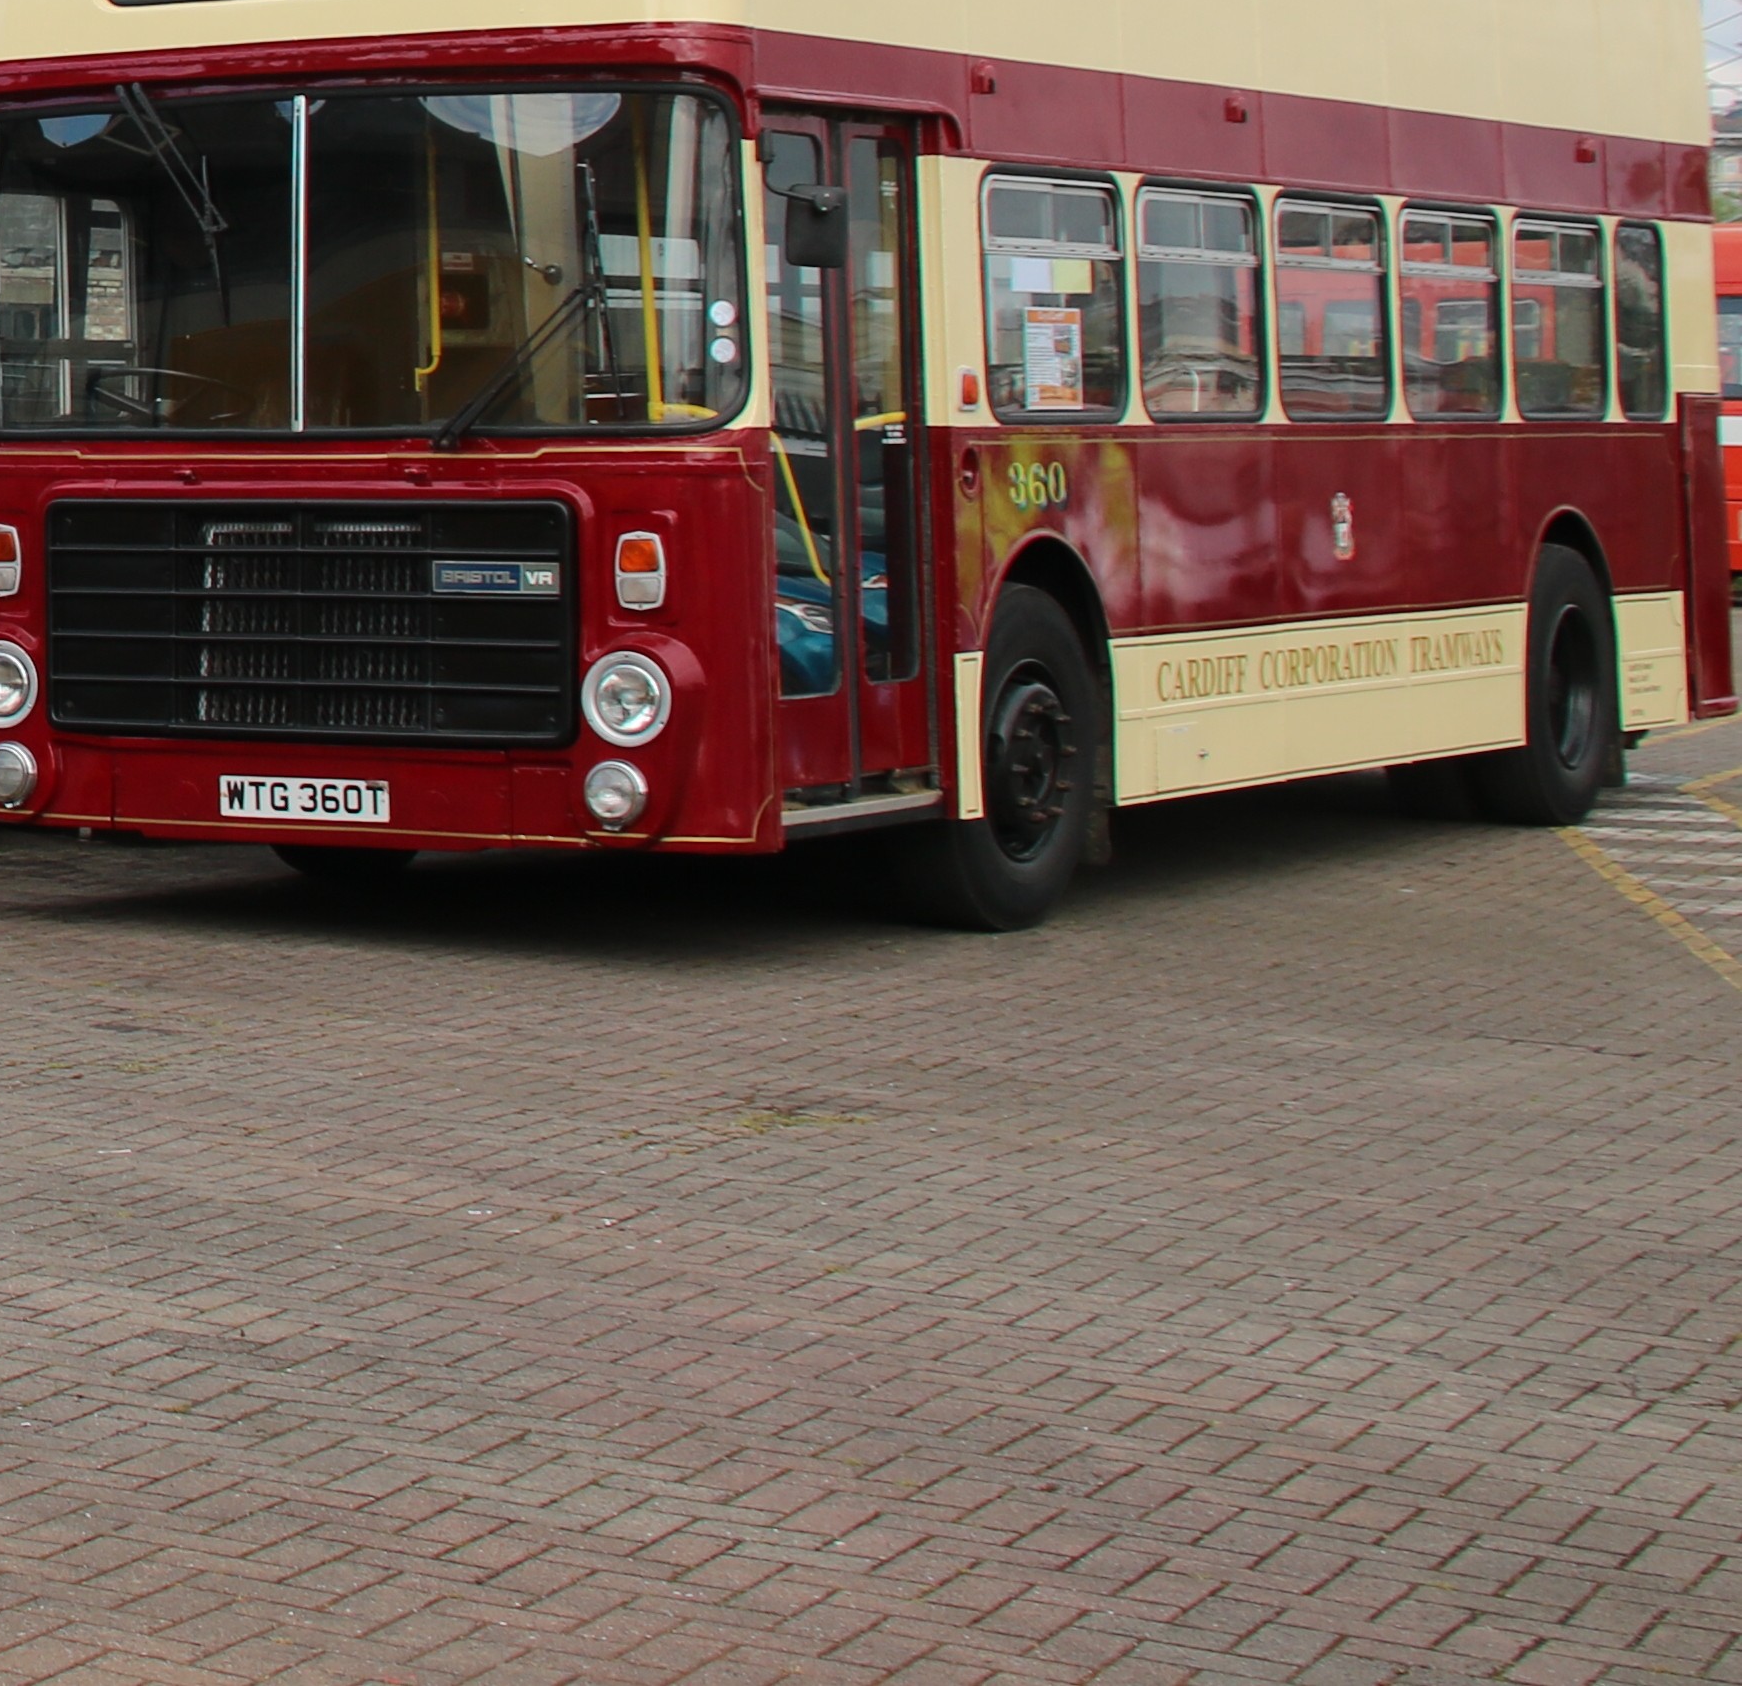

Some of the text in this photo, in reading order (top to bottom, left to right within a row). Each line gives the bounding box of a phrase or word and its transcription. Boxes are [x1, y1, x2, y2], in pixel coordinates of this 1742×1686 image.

[1007, 461, 1068, 512] 360
[441, 569, 554, 586] BRISTOL VR
[1156, 628, 1505, 702] CARDIFF CORPORATION TRAMWAYS
[226, 780, 385, 816] WTG 360T
